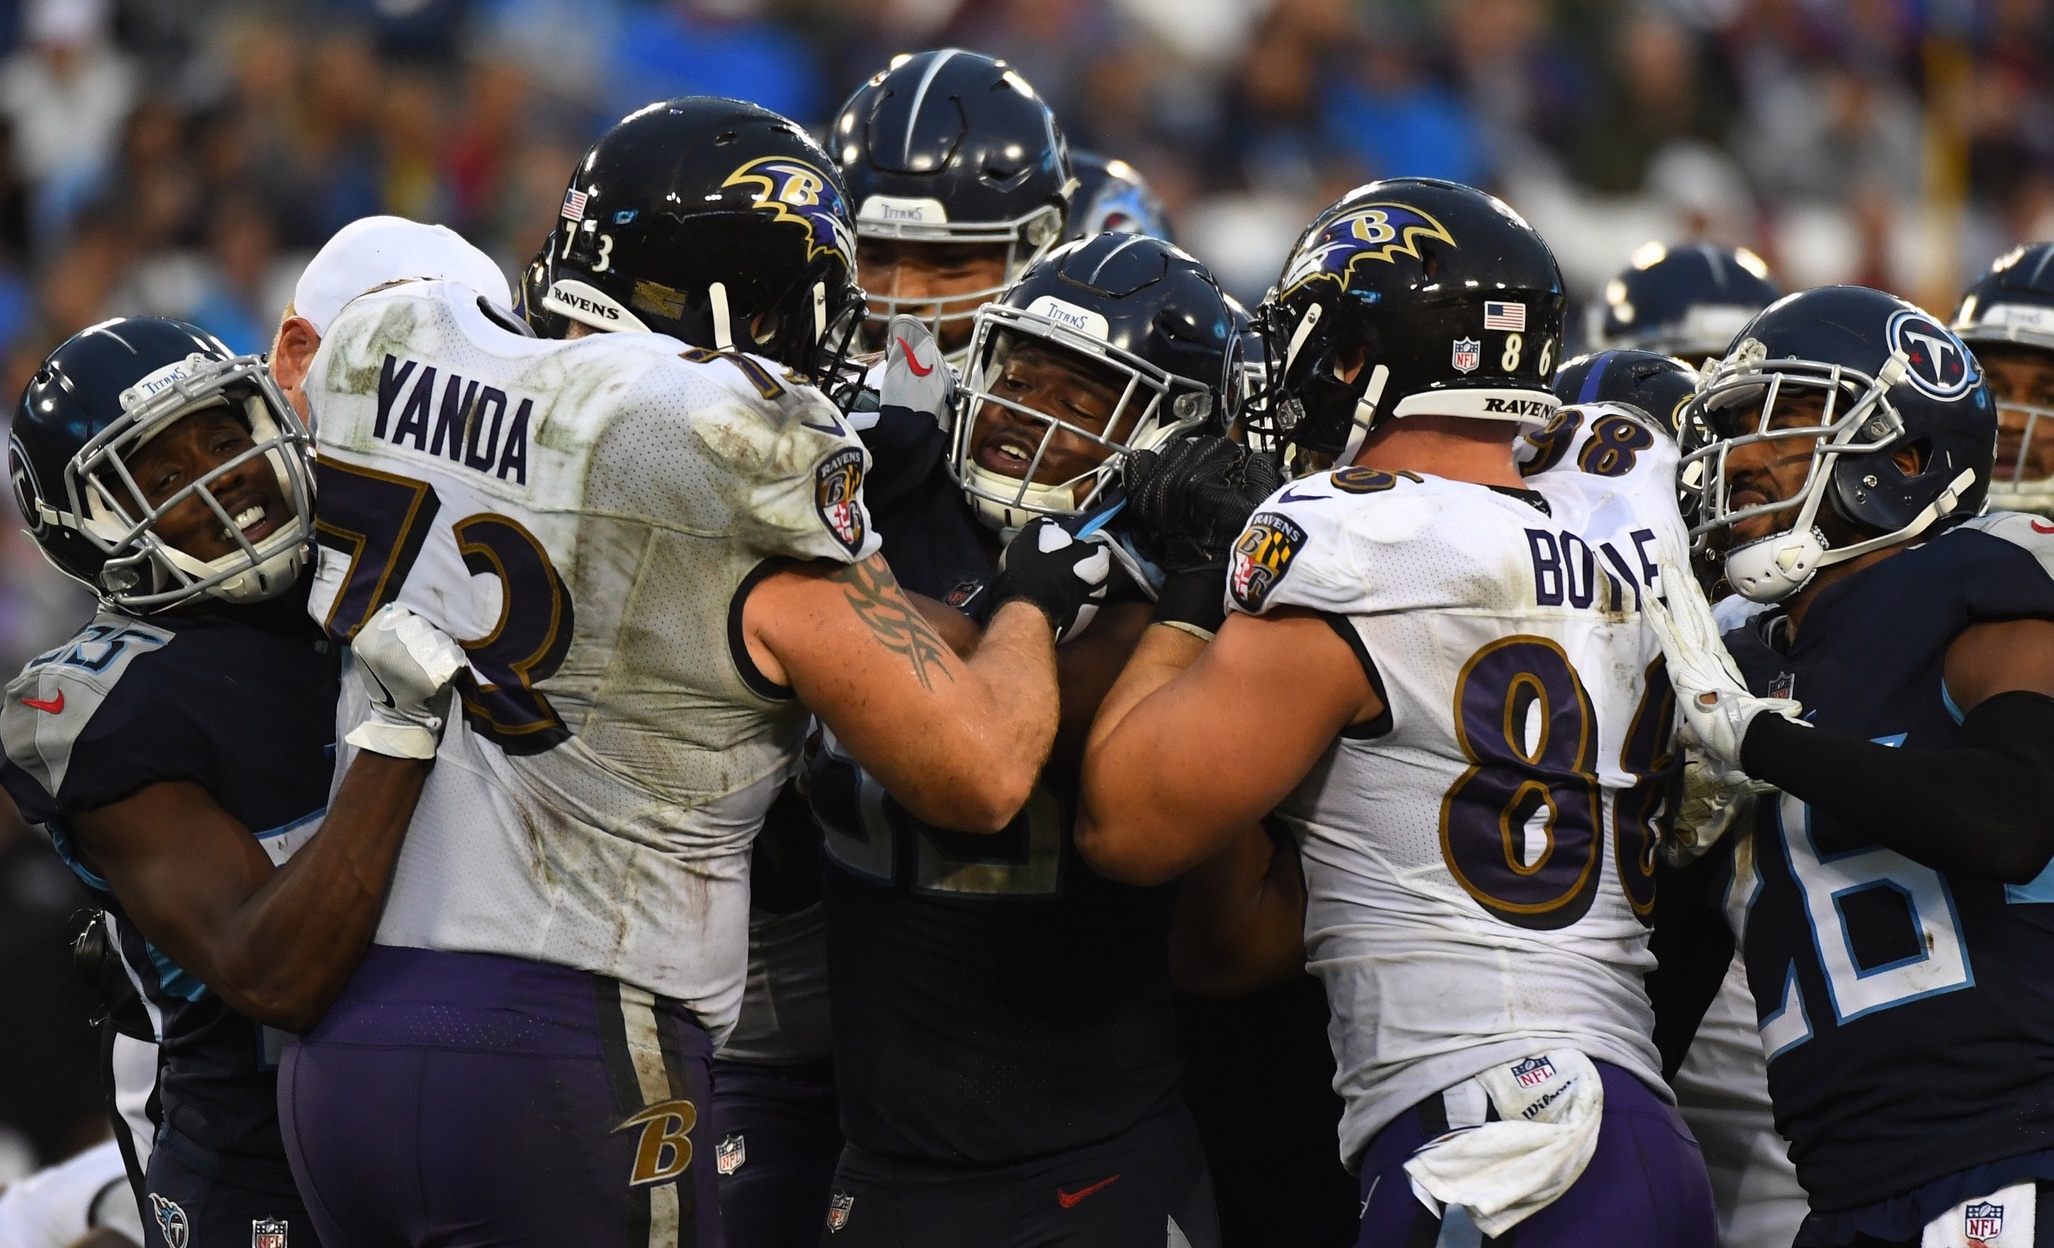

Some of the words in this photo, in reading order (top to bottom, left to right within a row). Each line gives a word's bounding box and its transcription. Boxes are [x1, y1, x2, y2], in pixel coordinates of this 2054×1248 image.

[1333, 209, 1396, 244] B
[554, 287, 620, 320] RAVENS
[1049, 303, 1088, 330] TITANS
[1456, 353, 1476, 367] NFL
[142, 367, 187, 395] TITANS
[373, 353, 534, 486] YANDA
[821, 452, 861, 478] RAVENS
[1254, 514, 1301, 543] RAVENS
[316, 453, 575, 756] 73
[1520, 1067, 1553, 1087] NFL
[610, 1099, 697, 1186] B
[722, 1151, 741, 1169] NFL
[1969, 1219, 1998, 1237] NFL
